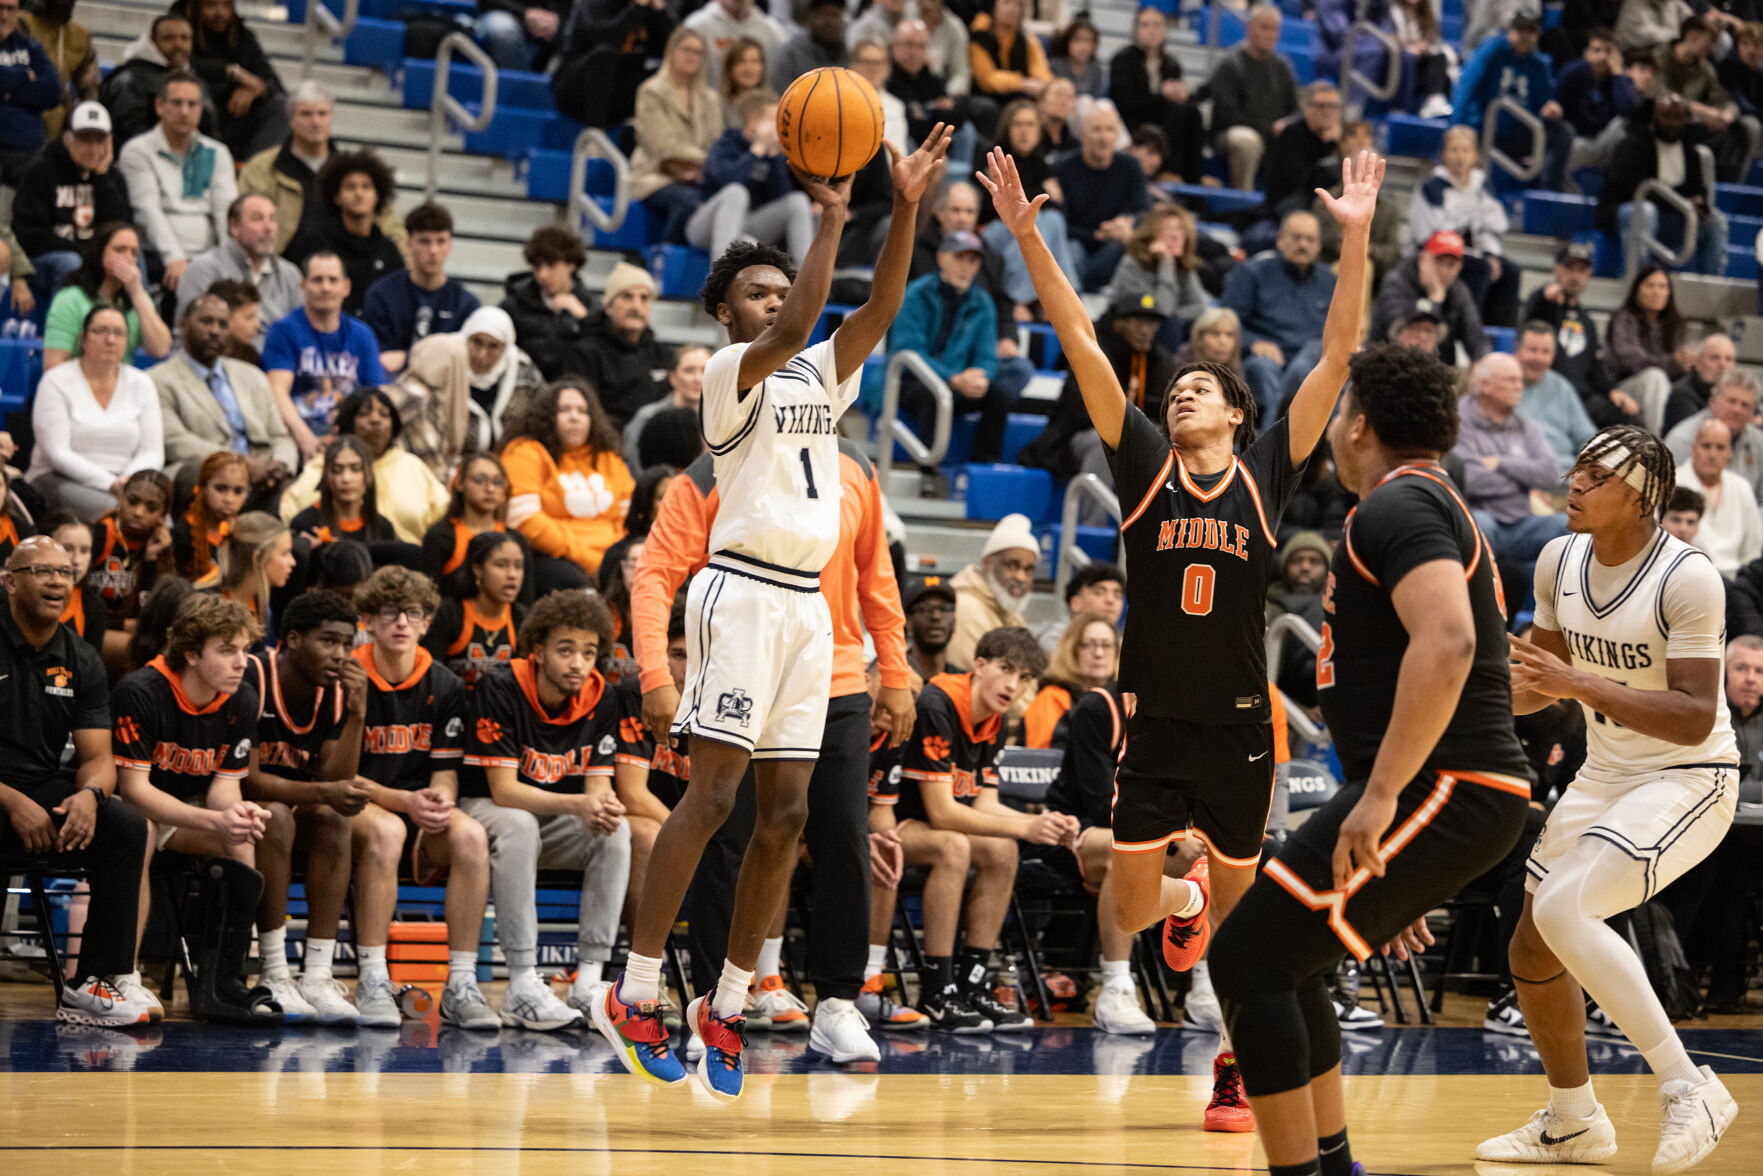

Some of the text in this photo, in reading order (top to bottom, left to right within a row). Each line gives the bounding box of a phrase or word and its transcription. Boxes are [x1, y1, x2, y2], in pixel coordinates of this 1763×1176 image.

[772, 404, 837, 435] VIKING
[800, 447, 819, 499] 1
[1156, 518, 1250, 562] MIDDLE
[1180, 563, 1217, 616] 0
[998, 765, 1061, 785] VIKIN
